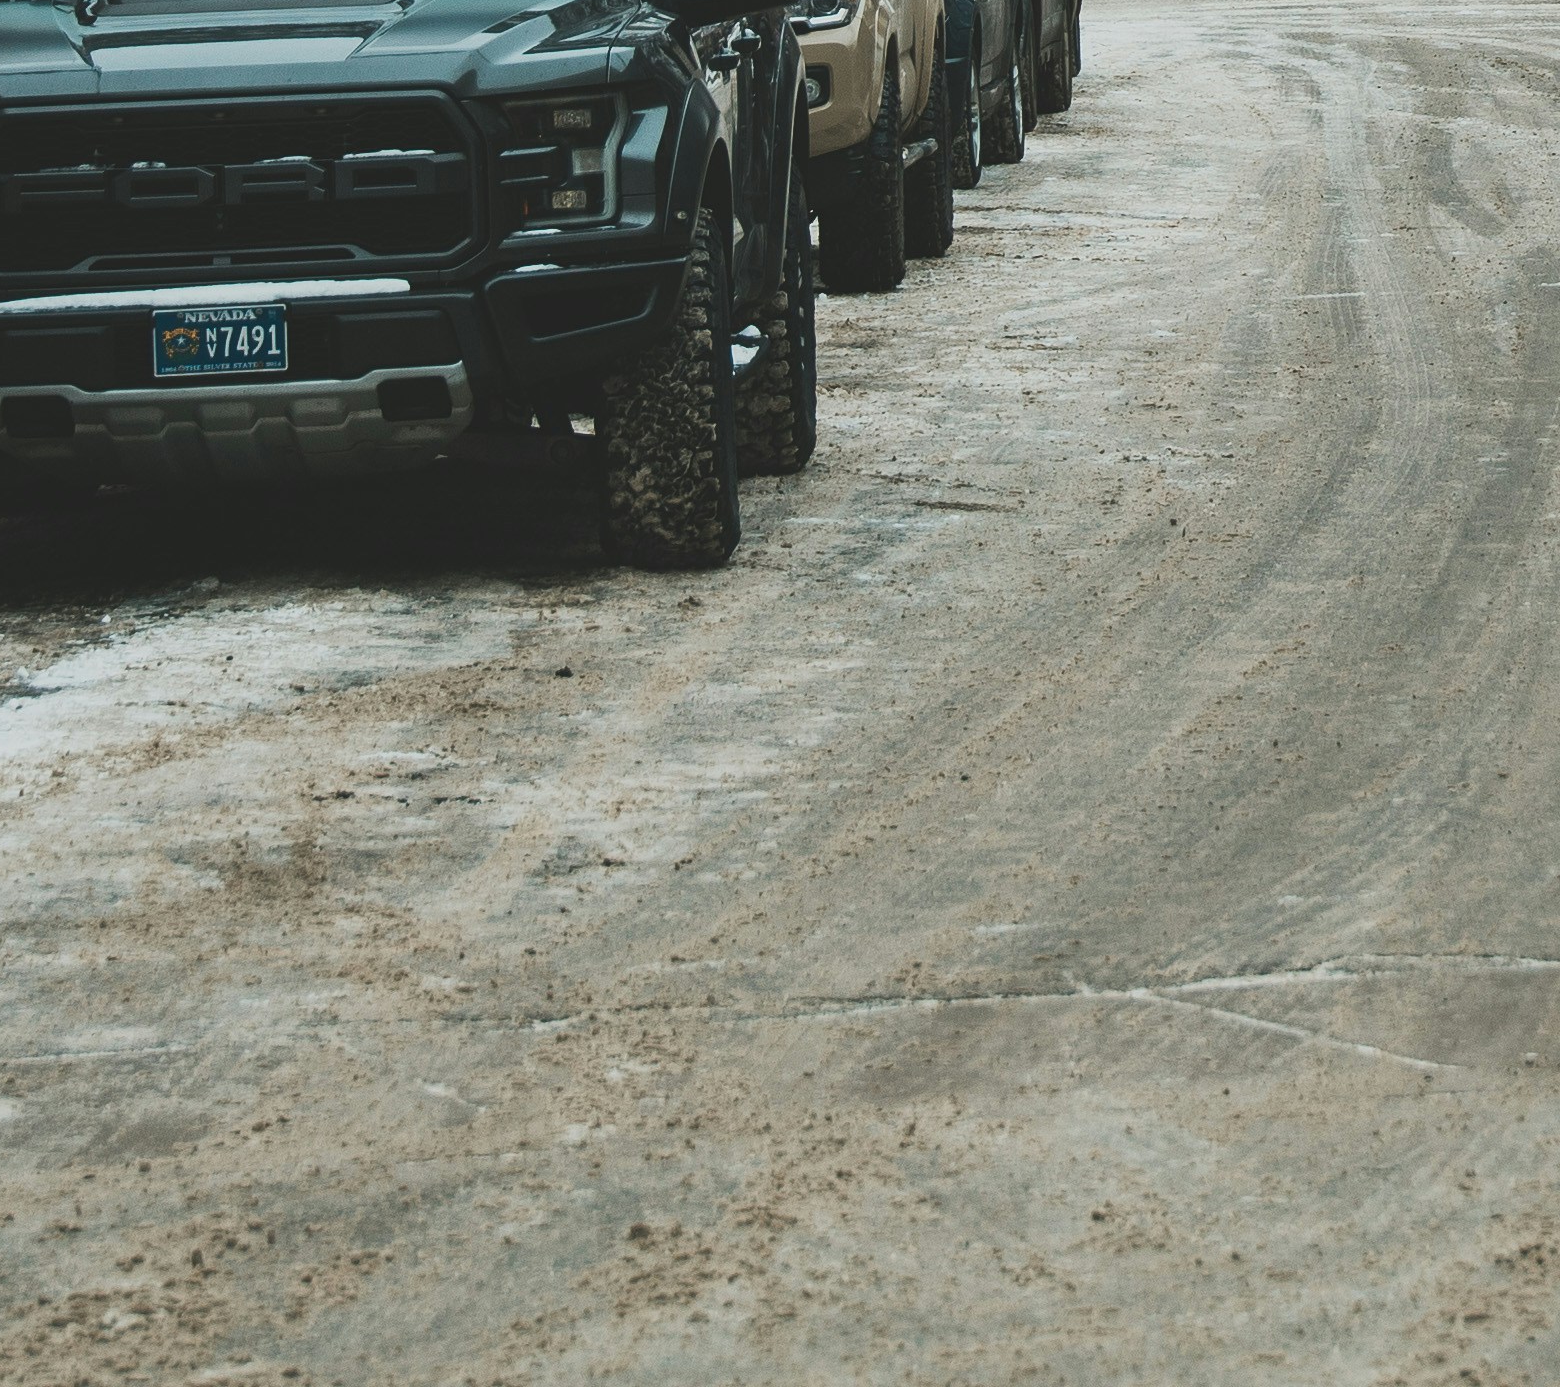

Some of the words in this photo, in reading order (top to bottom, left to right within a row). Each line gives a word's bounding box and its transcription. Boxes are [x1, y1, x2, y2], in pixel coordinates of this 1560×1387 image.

[4, 155, 438, 209] FORD
[184, 308, 257, 323] NEVADA
[220, 324, 281, 358] 7491
